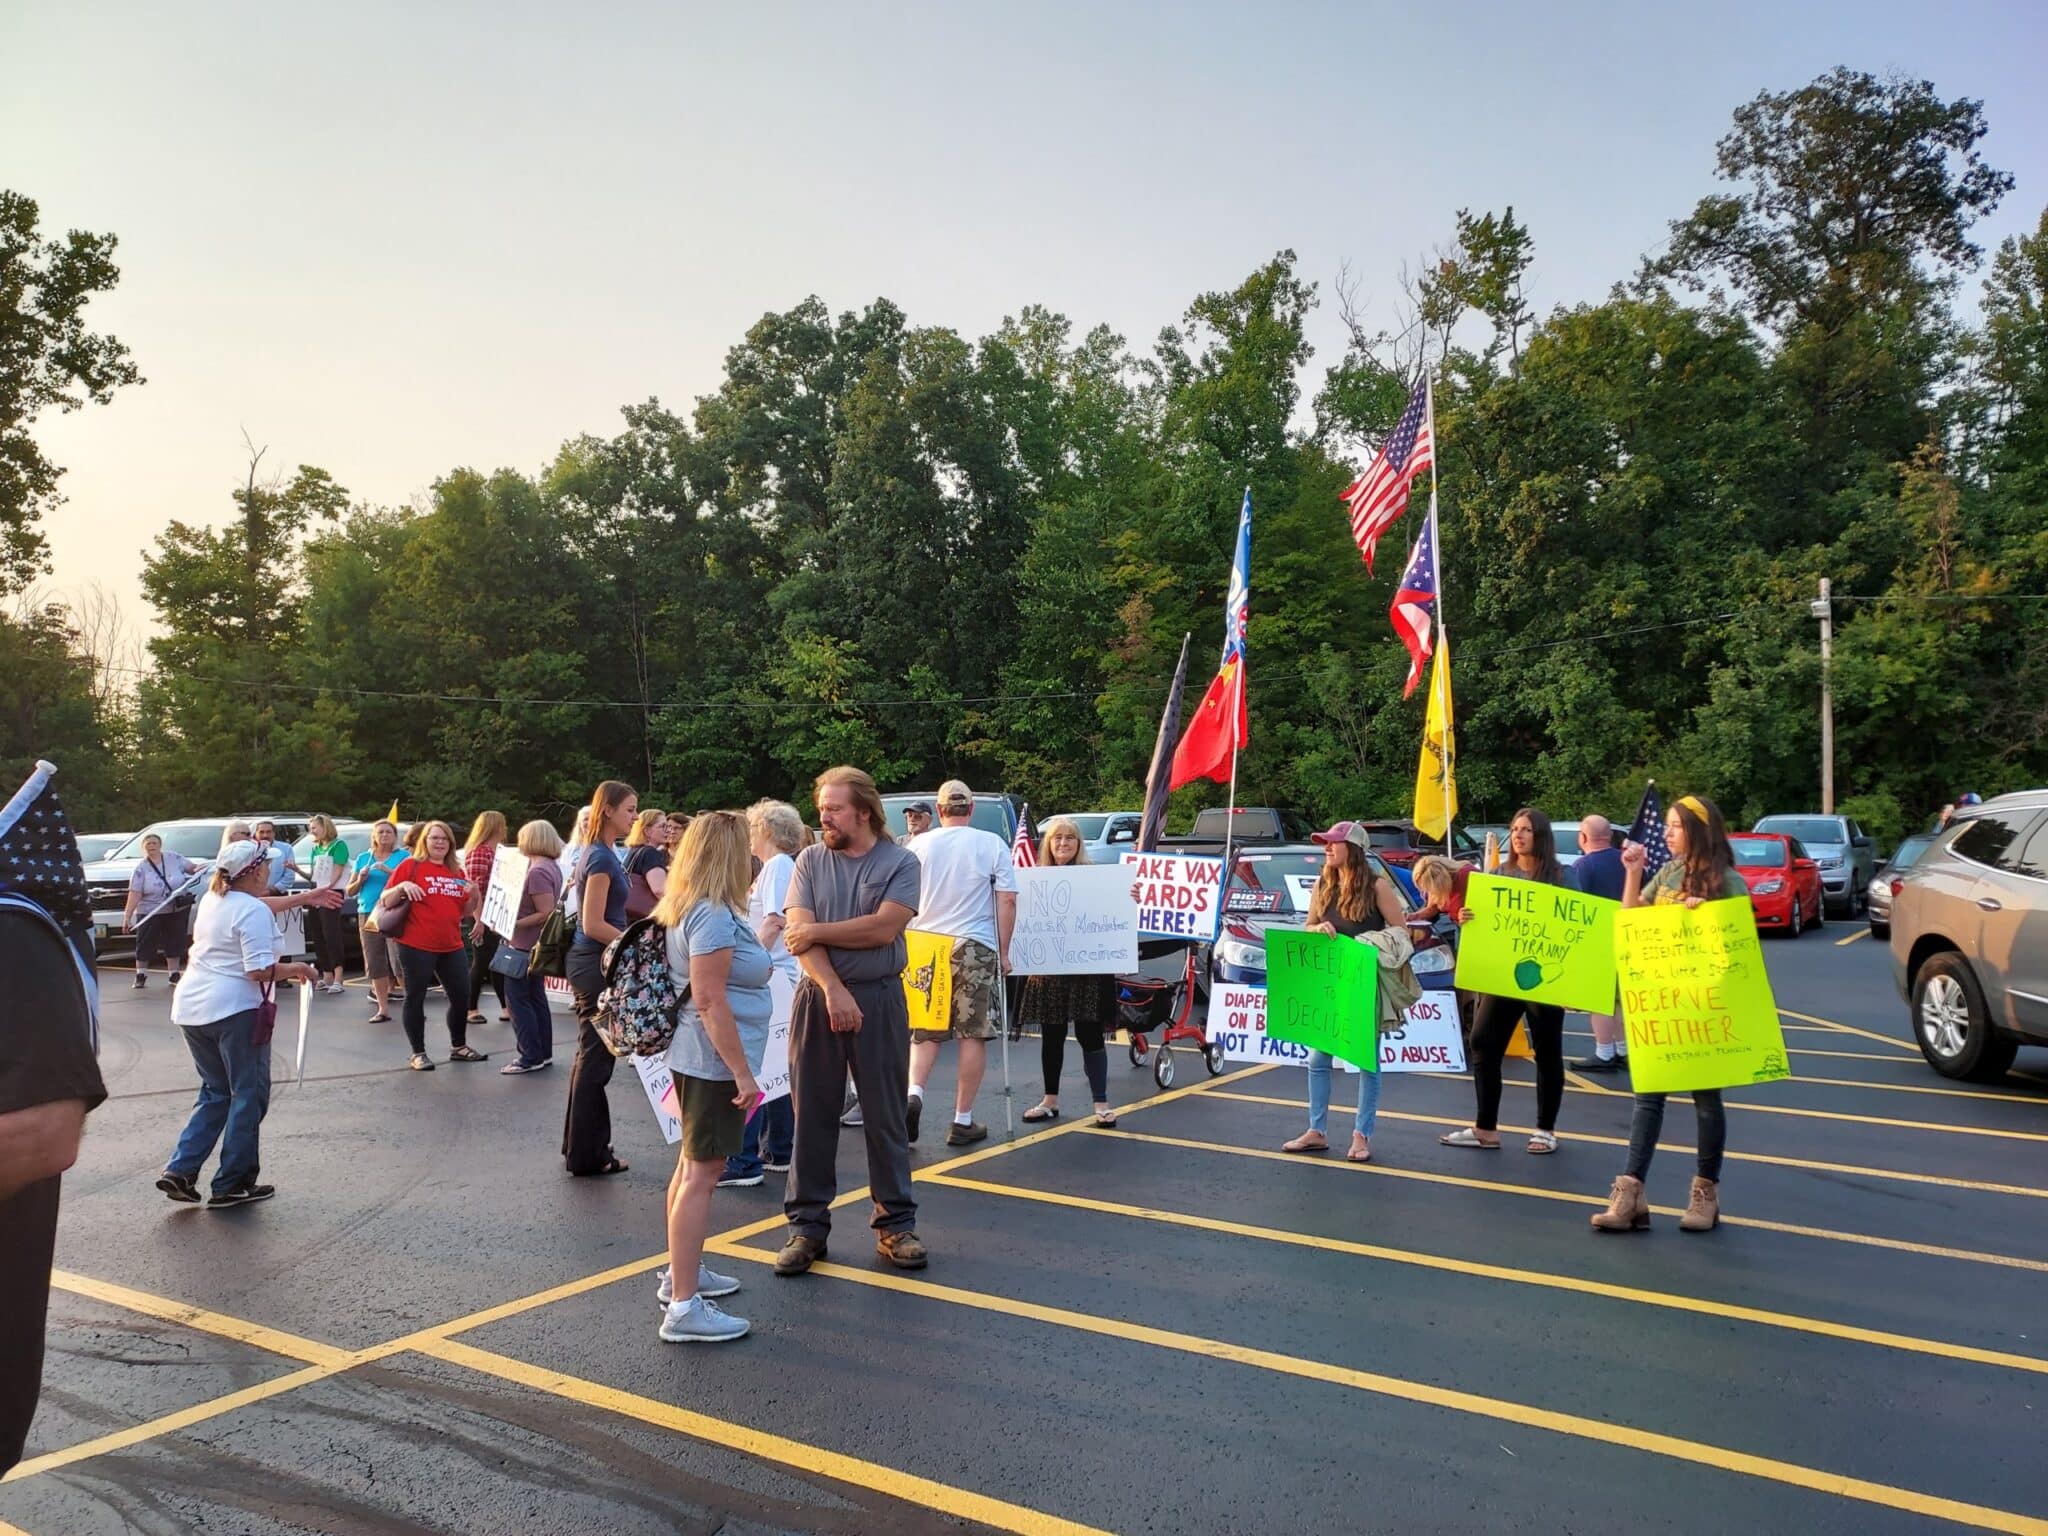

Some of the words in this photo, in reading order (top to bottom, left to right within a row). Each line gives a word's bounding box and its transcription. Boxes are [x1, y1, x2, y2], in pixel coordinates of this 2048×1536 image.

[1185, 861, 1222, 885] VAX
[1030, 880, 1072, 917] NO
[1491, 887, 1536, 913] THE
[1554, 896, 1597, 925] NEW
[1139, 908, 1196, 934] HERE!
[1493, 913, 1551, 940] SYMBOL
[1565, 928, 1585, 944] OF
[1671, 920, 1703, 940] who
[1013, 936, 1047, 968] NO
[1512, 938, 1571, 963] TYRANNY
[1408, 1003, 1442, 1020] KIDS
[1625, 986, 1729, 1015] DESERVE
[1228, 1012, 1248, 1030] ON
[1287, 996, 1351, 1045] DECIDE
[1631, 1015, 1742, 1048] NEITHER
[1215, 1032, 1249, 1052] NOT
[1260, 1036, 1309, 1060] FACES
[1401, 1046, 1451, 1064] ABUSE
